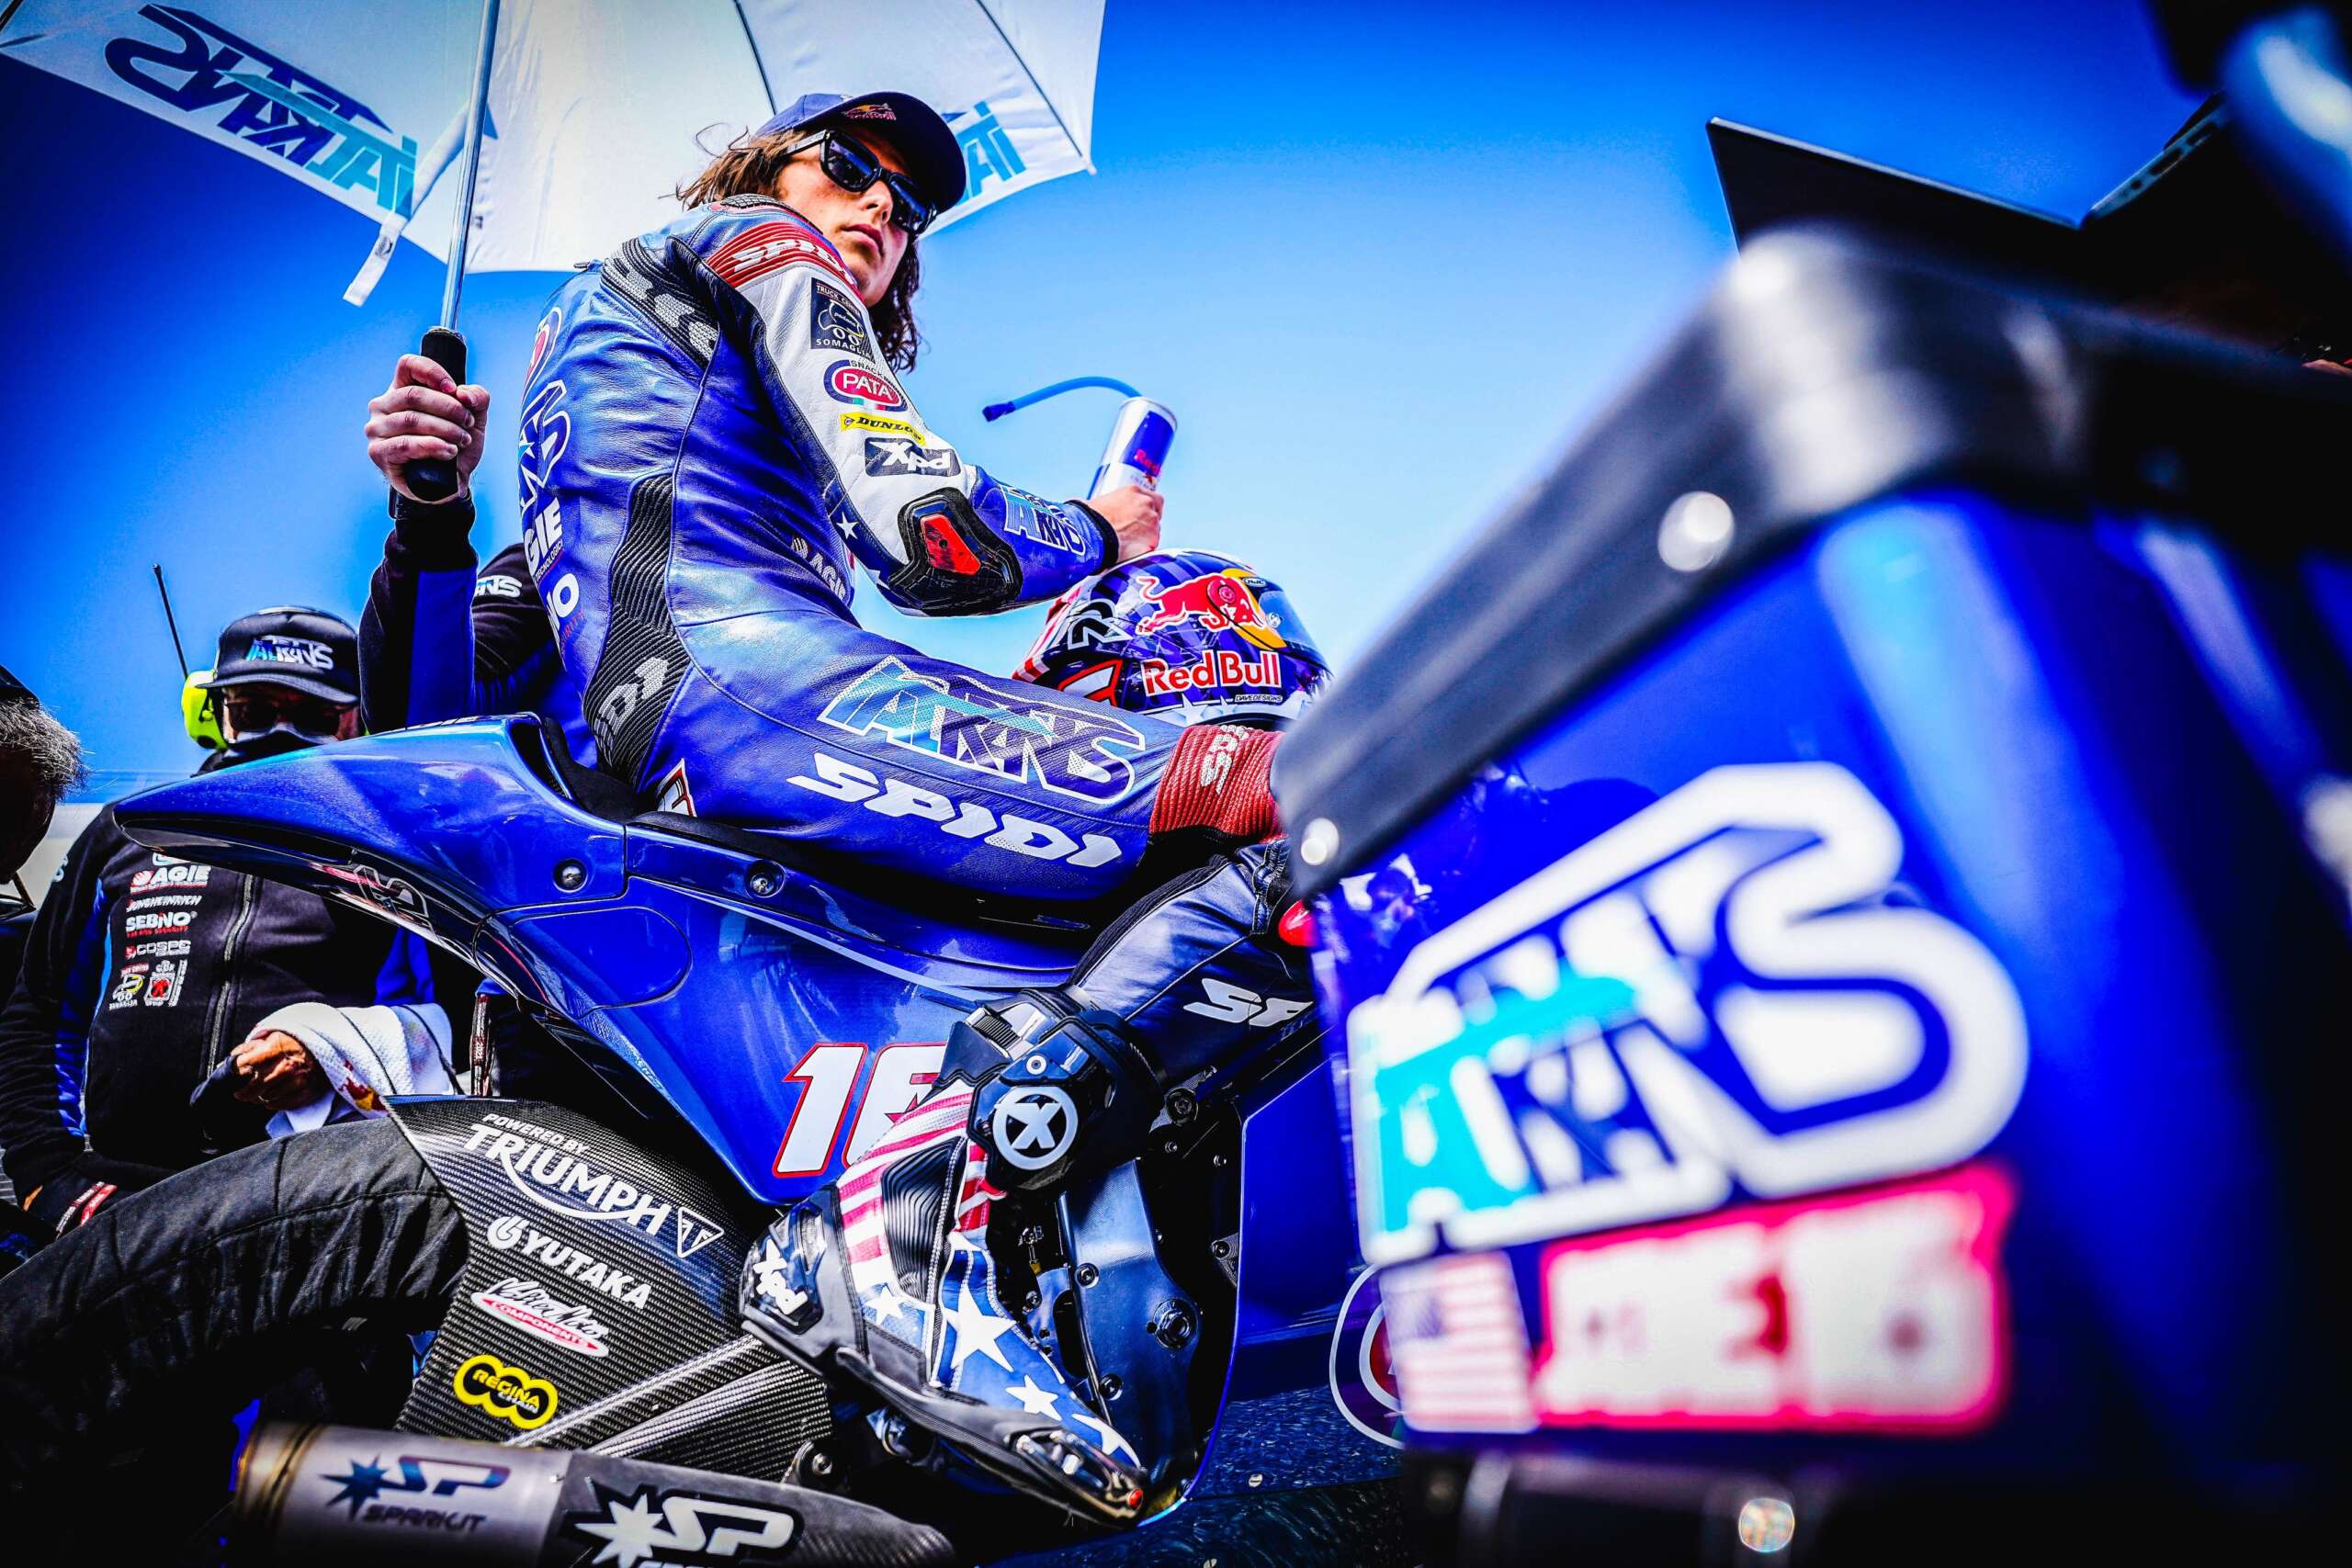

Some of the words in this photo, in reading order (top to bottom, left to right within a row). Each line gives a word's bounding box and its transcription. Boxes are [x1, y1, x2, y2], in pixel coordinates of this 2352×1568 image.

[842, 373, 894, 400] PATA
[1141, 650, 1216, 696] Red
[1217, 650, 1282, 688] Bull
[786, 752, 1123, 867] SPIDI
[482, 1113, 565, 1147] POWERED
[566, 1139, 591, 1155] BY
[463, 1123, 672, 1236] TRIUMPH
[520, 1228, 652, 1310] YUTAKA
[492, 1300, 587, 1346] COMPONENTS
[472, 1369, 541, 1405] REGINA
[656, 1495, 795, 1554] SP
